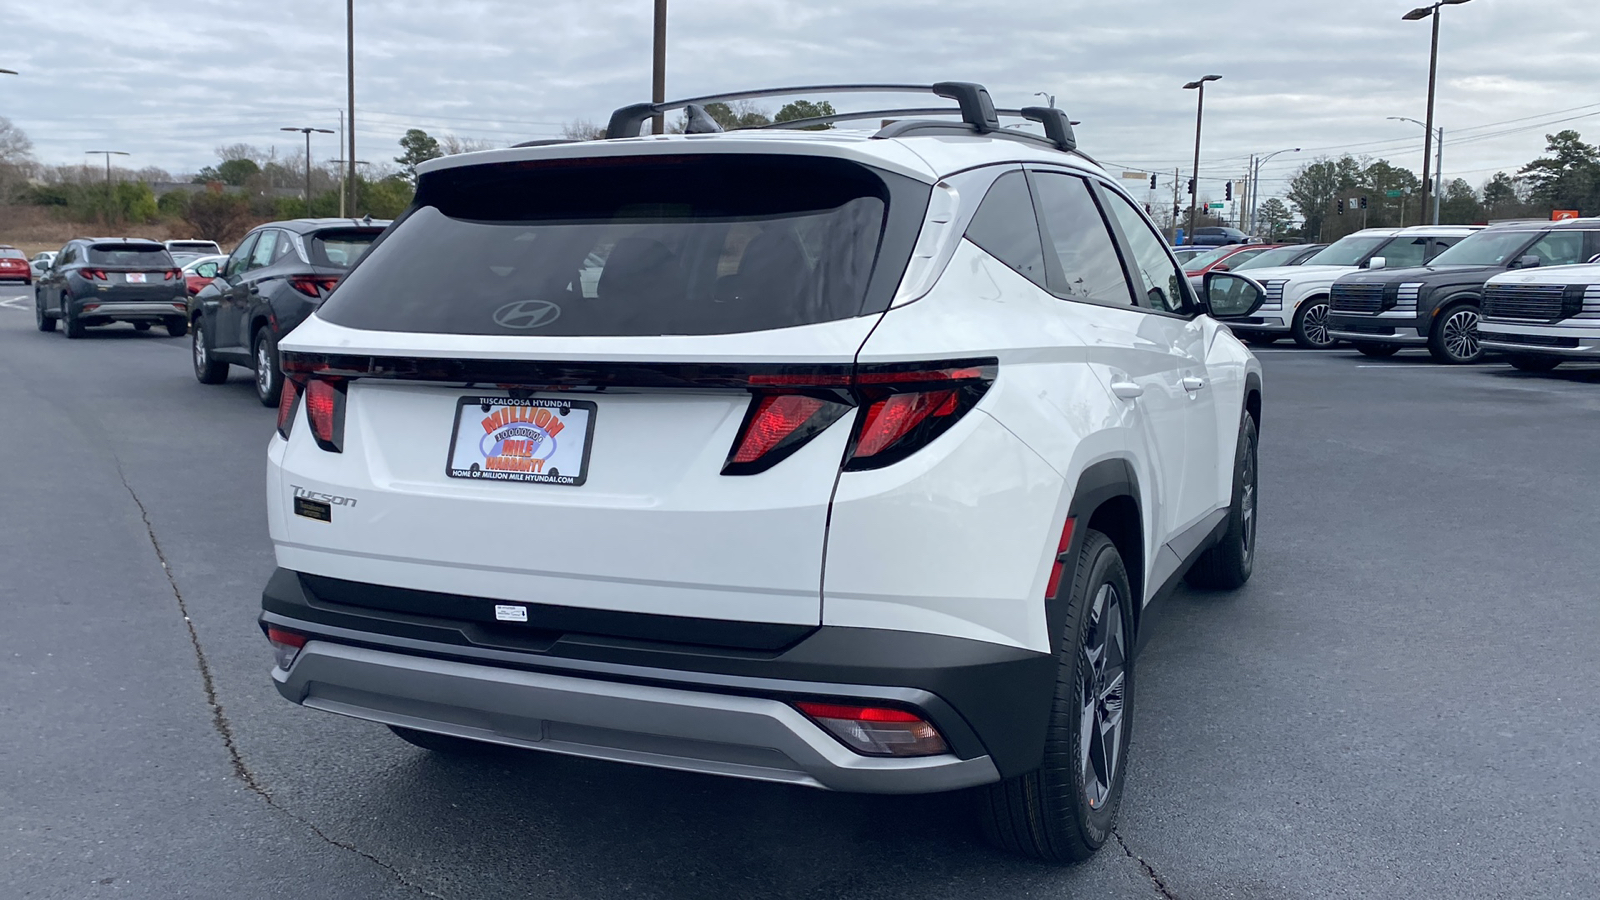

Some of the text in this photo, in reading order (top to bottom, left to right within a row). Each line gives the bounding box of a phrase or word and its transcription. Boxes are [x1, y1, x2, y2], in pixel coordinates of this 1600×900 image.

[480, 397, 571, 408] TUSCALOOSA HYUNDAI
[481, 406, 565, 438] MILLION
[502, 440, 533, 457] MILE
[486, 457, 545, 472] WARRANTY
[482, 472, 508, 480] MILLION
[525, 475, 574, 484] HYUNDAI.COM
